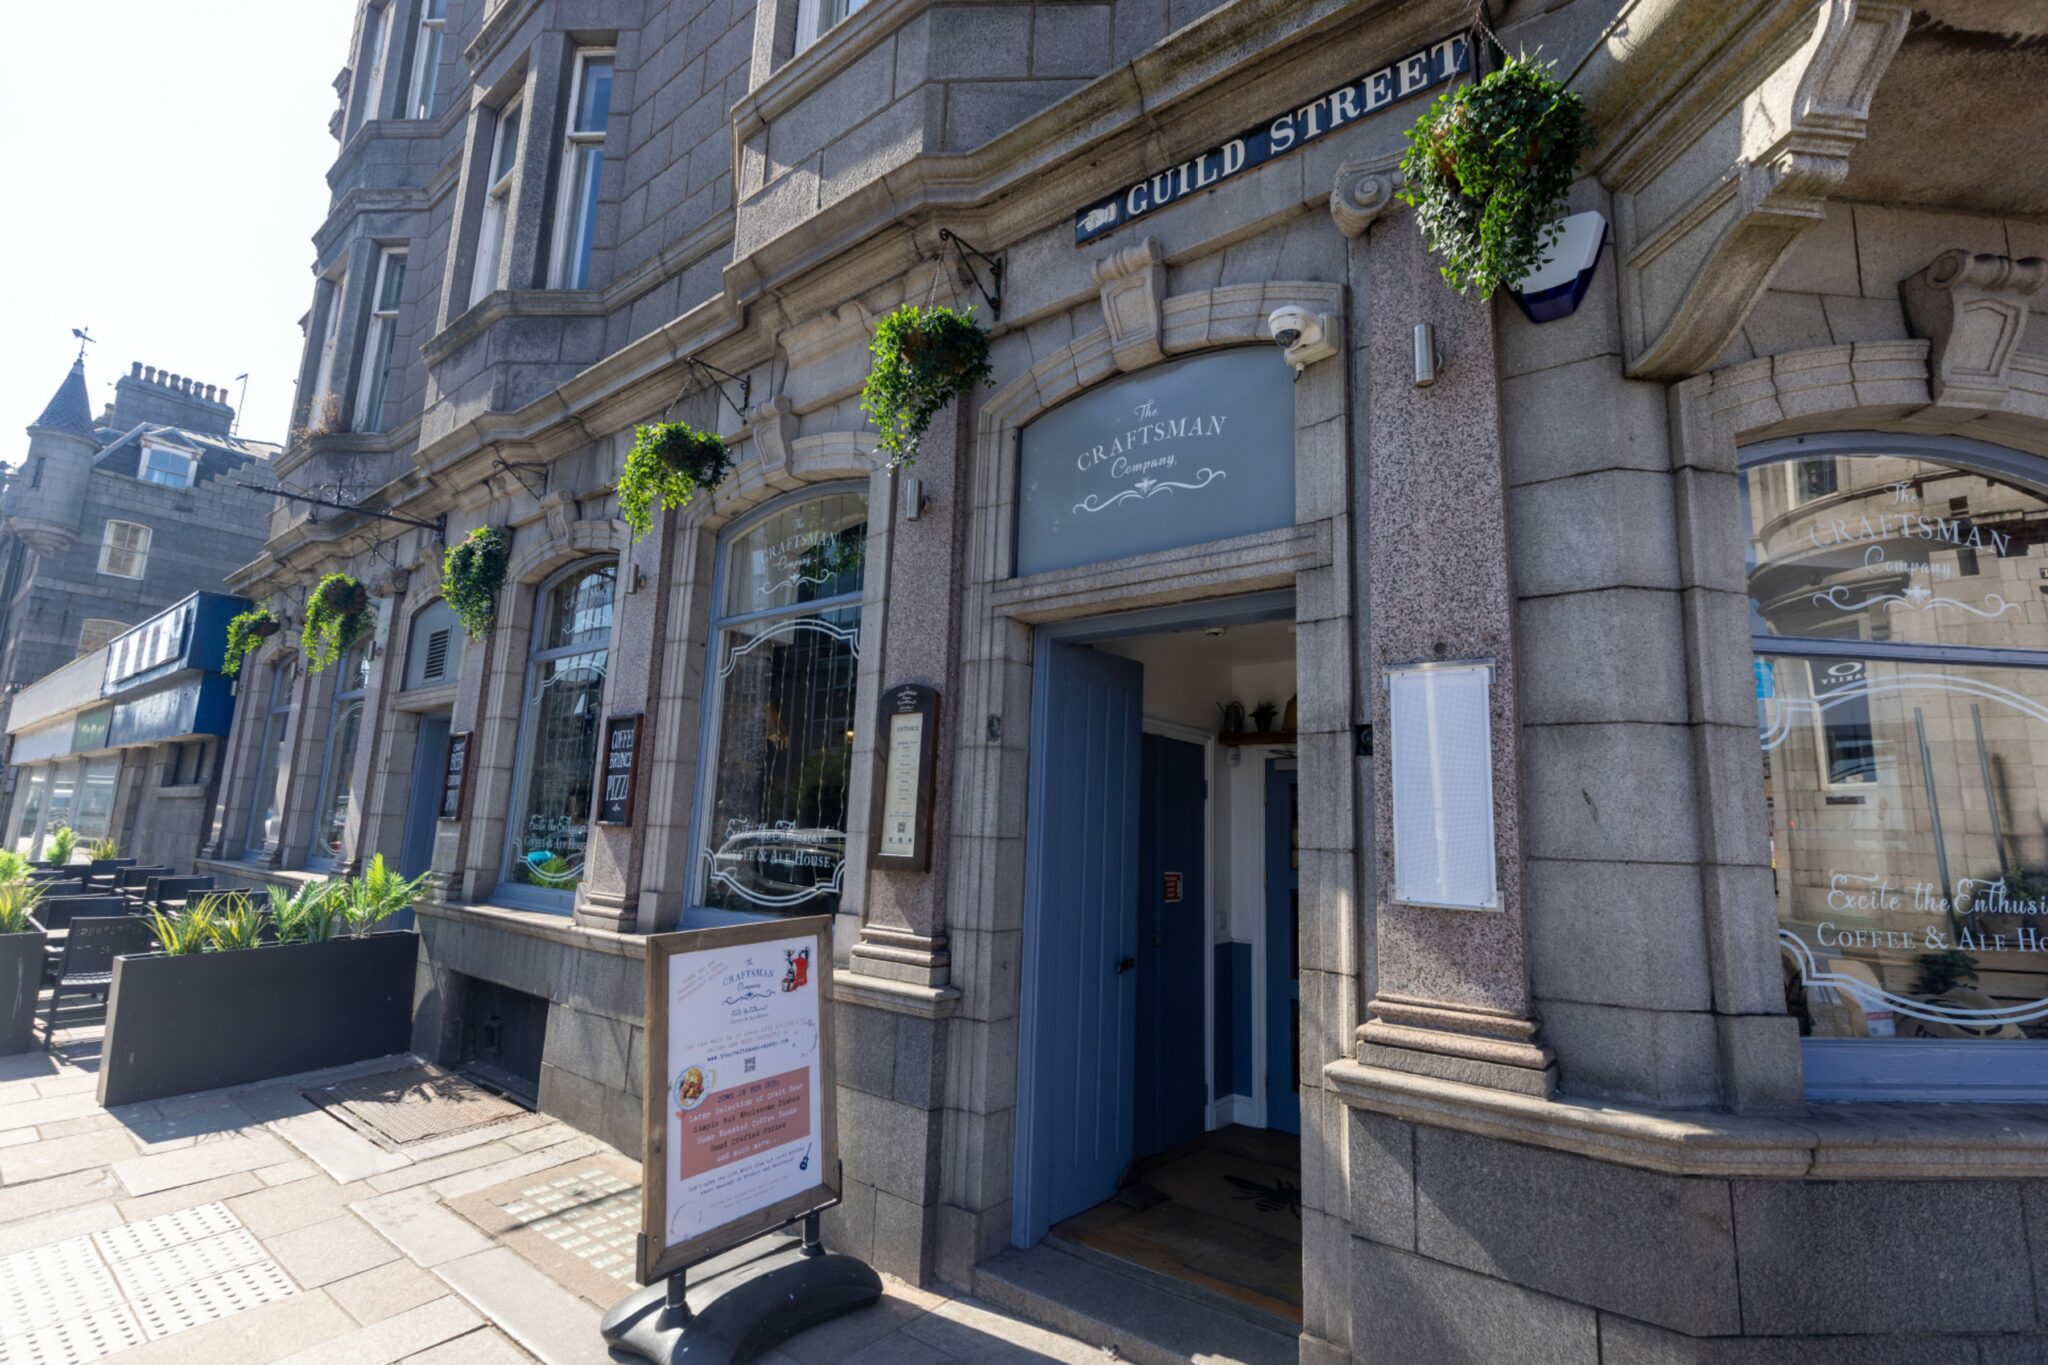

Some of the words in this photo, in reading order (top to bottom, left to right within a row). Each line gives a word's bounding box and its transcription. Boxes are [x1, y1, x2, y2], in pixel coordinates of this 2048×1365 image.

[1126, 138, 1246, 217] GUILD
[1269, 32, 1467, 154] STREET
[1133, 399, 1158, 421] The
[1076, 415, 1227, 471] CRAFTSMAN
[1882, 481, 1920, 505] The
[1808, 513, 2012, 558] CRAFTSMAN
[1863, 545, 1953, 579] Company
[794, 849, 831, 868] HOUSE
[1827, 873, 1901, 912] Excite
[1905, 882, 1950, 913] the
[1816, 921, 1916, 949] COFFEE
[1924, 924, 1949, 950] &
[1958, 926, 2008, 952] ALE
[723, 968, 775, 986] CRAFTSMAN
[688, 1111, 711, 1123] Large
[715, 1098, 753, 1115] Selection
[767, 1088, 786, 1100] Craft
[693, 1121, 719, 1134] Simple
[723, 1115, 736, 1124] but
[751, 1115, 775, 1127] Coffee
[731, 1130, 760, 1146] Crafted
